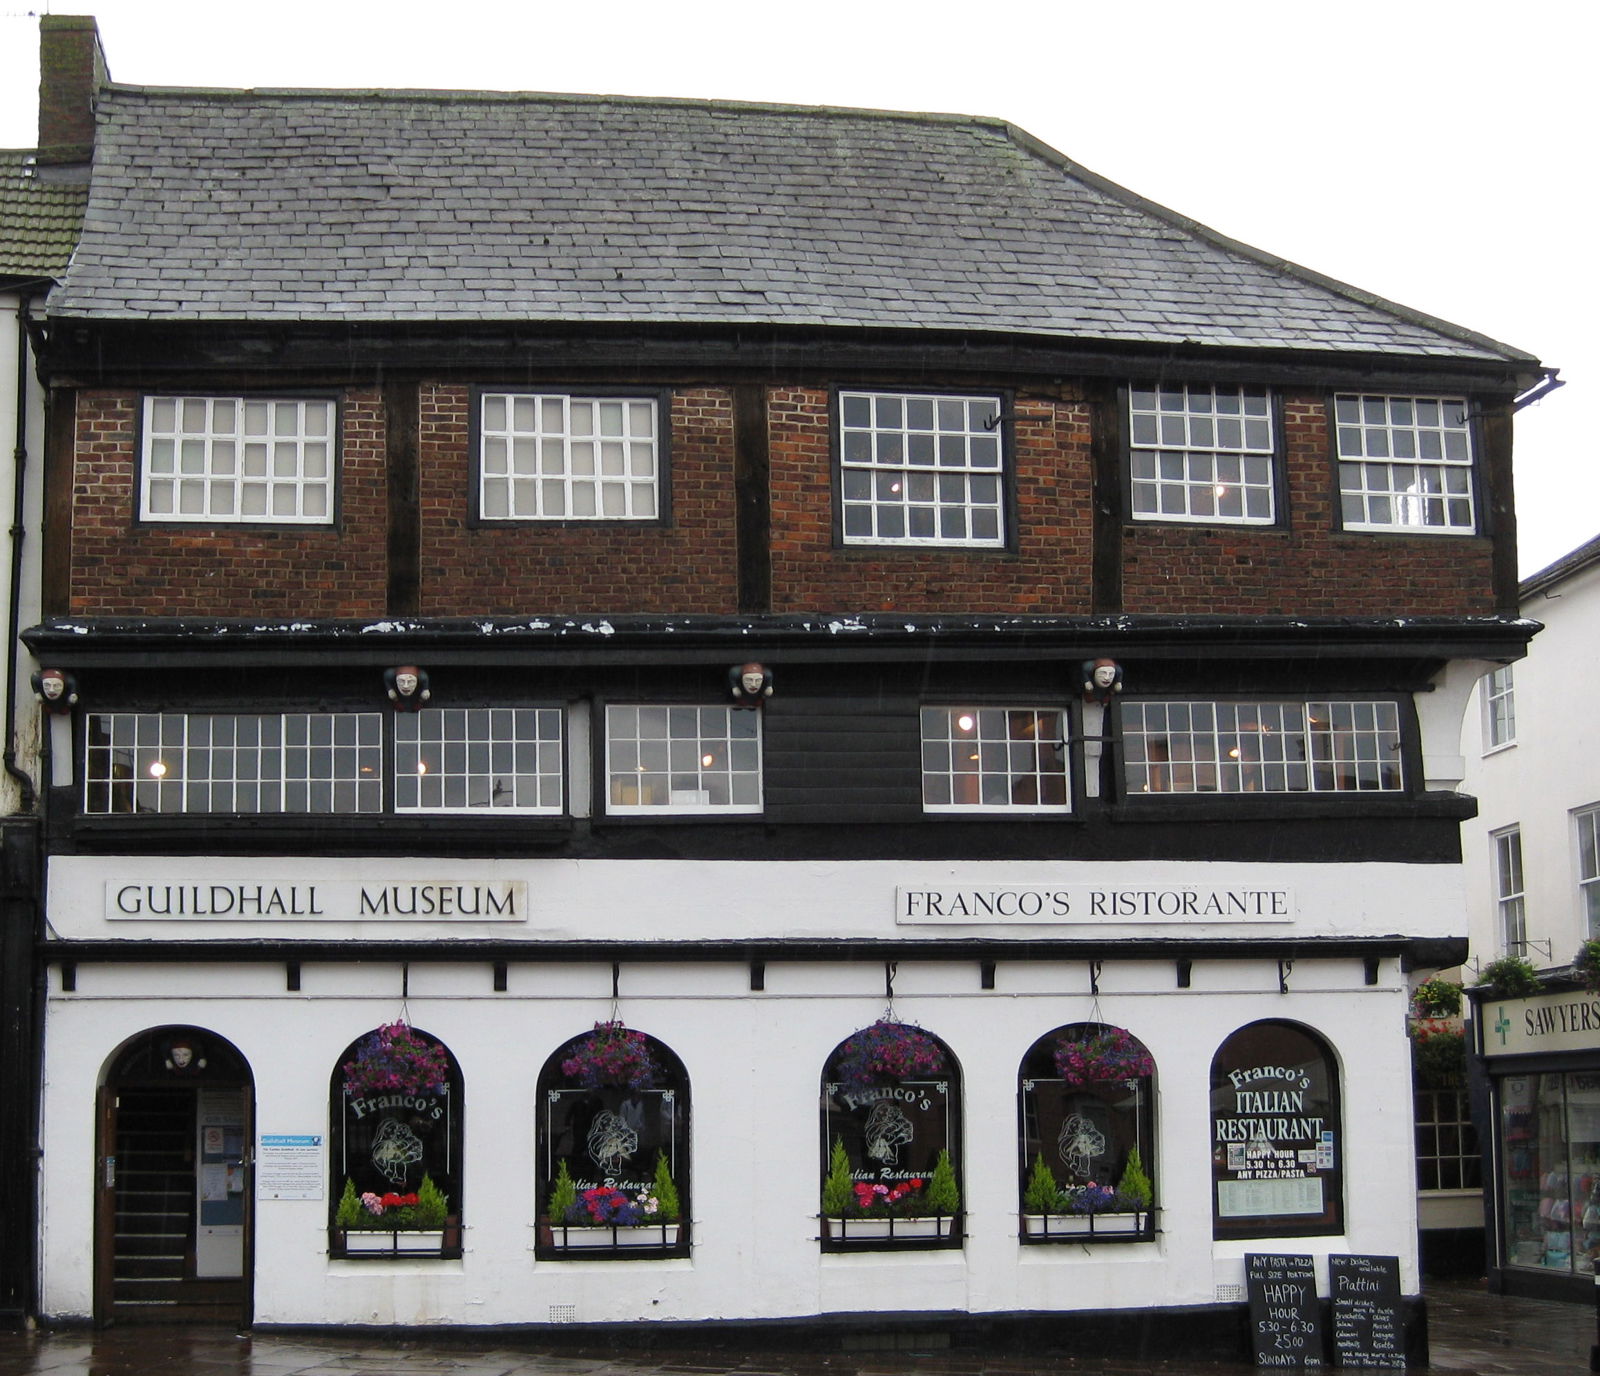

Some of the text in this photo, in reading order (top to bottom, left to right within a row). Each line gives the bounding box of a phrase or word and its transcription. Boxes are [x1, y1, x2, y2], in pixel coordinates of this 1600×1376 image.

[116, 884, 517, 915] GUILDHALL MUSEUM
[906, 890, 1288, 916] FRANCO'S RISTORANTE
[1525, 1001, 1600, 1036] SAWYERS
[1228, 1065, 1310, 1090] Franco's
[350, 1094, 443, 1119] Franco's
[1235, 1091, 1304, 1114] ITALIAN
[1215, 1117, 1324, 1141] RESTAURANT
[1246, 1150, 1272, 1160] HAPPY
[1274, 1149, 1295, 1159] HOUR
[879, 1167, 935, 1180] Restauran
[1246, 1160, 1296, 1169] 5.30 to 6.30
[1237, 1169, 1306, 1180] ANY PIZZA/PASTA
[1294, 1257, 1314, 1267] PIZZA
[1250, 1271, 1264, 1279] FULL
[1268, 1271, 1282, 1279] SIZE
[1338, 1275, 1379, 1291] Piattini
[1263, 1284, 1306, 1306] HAPPY
[1269, 1307, 1300, 1320] HOUR
